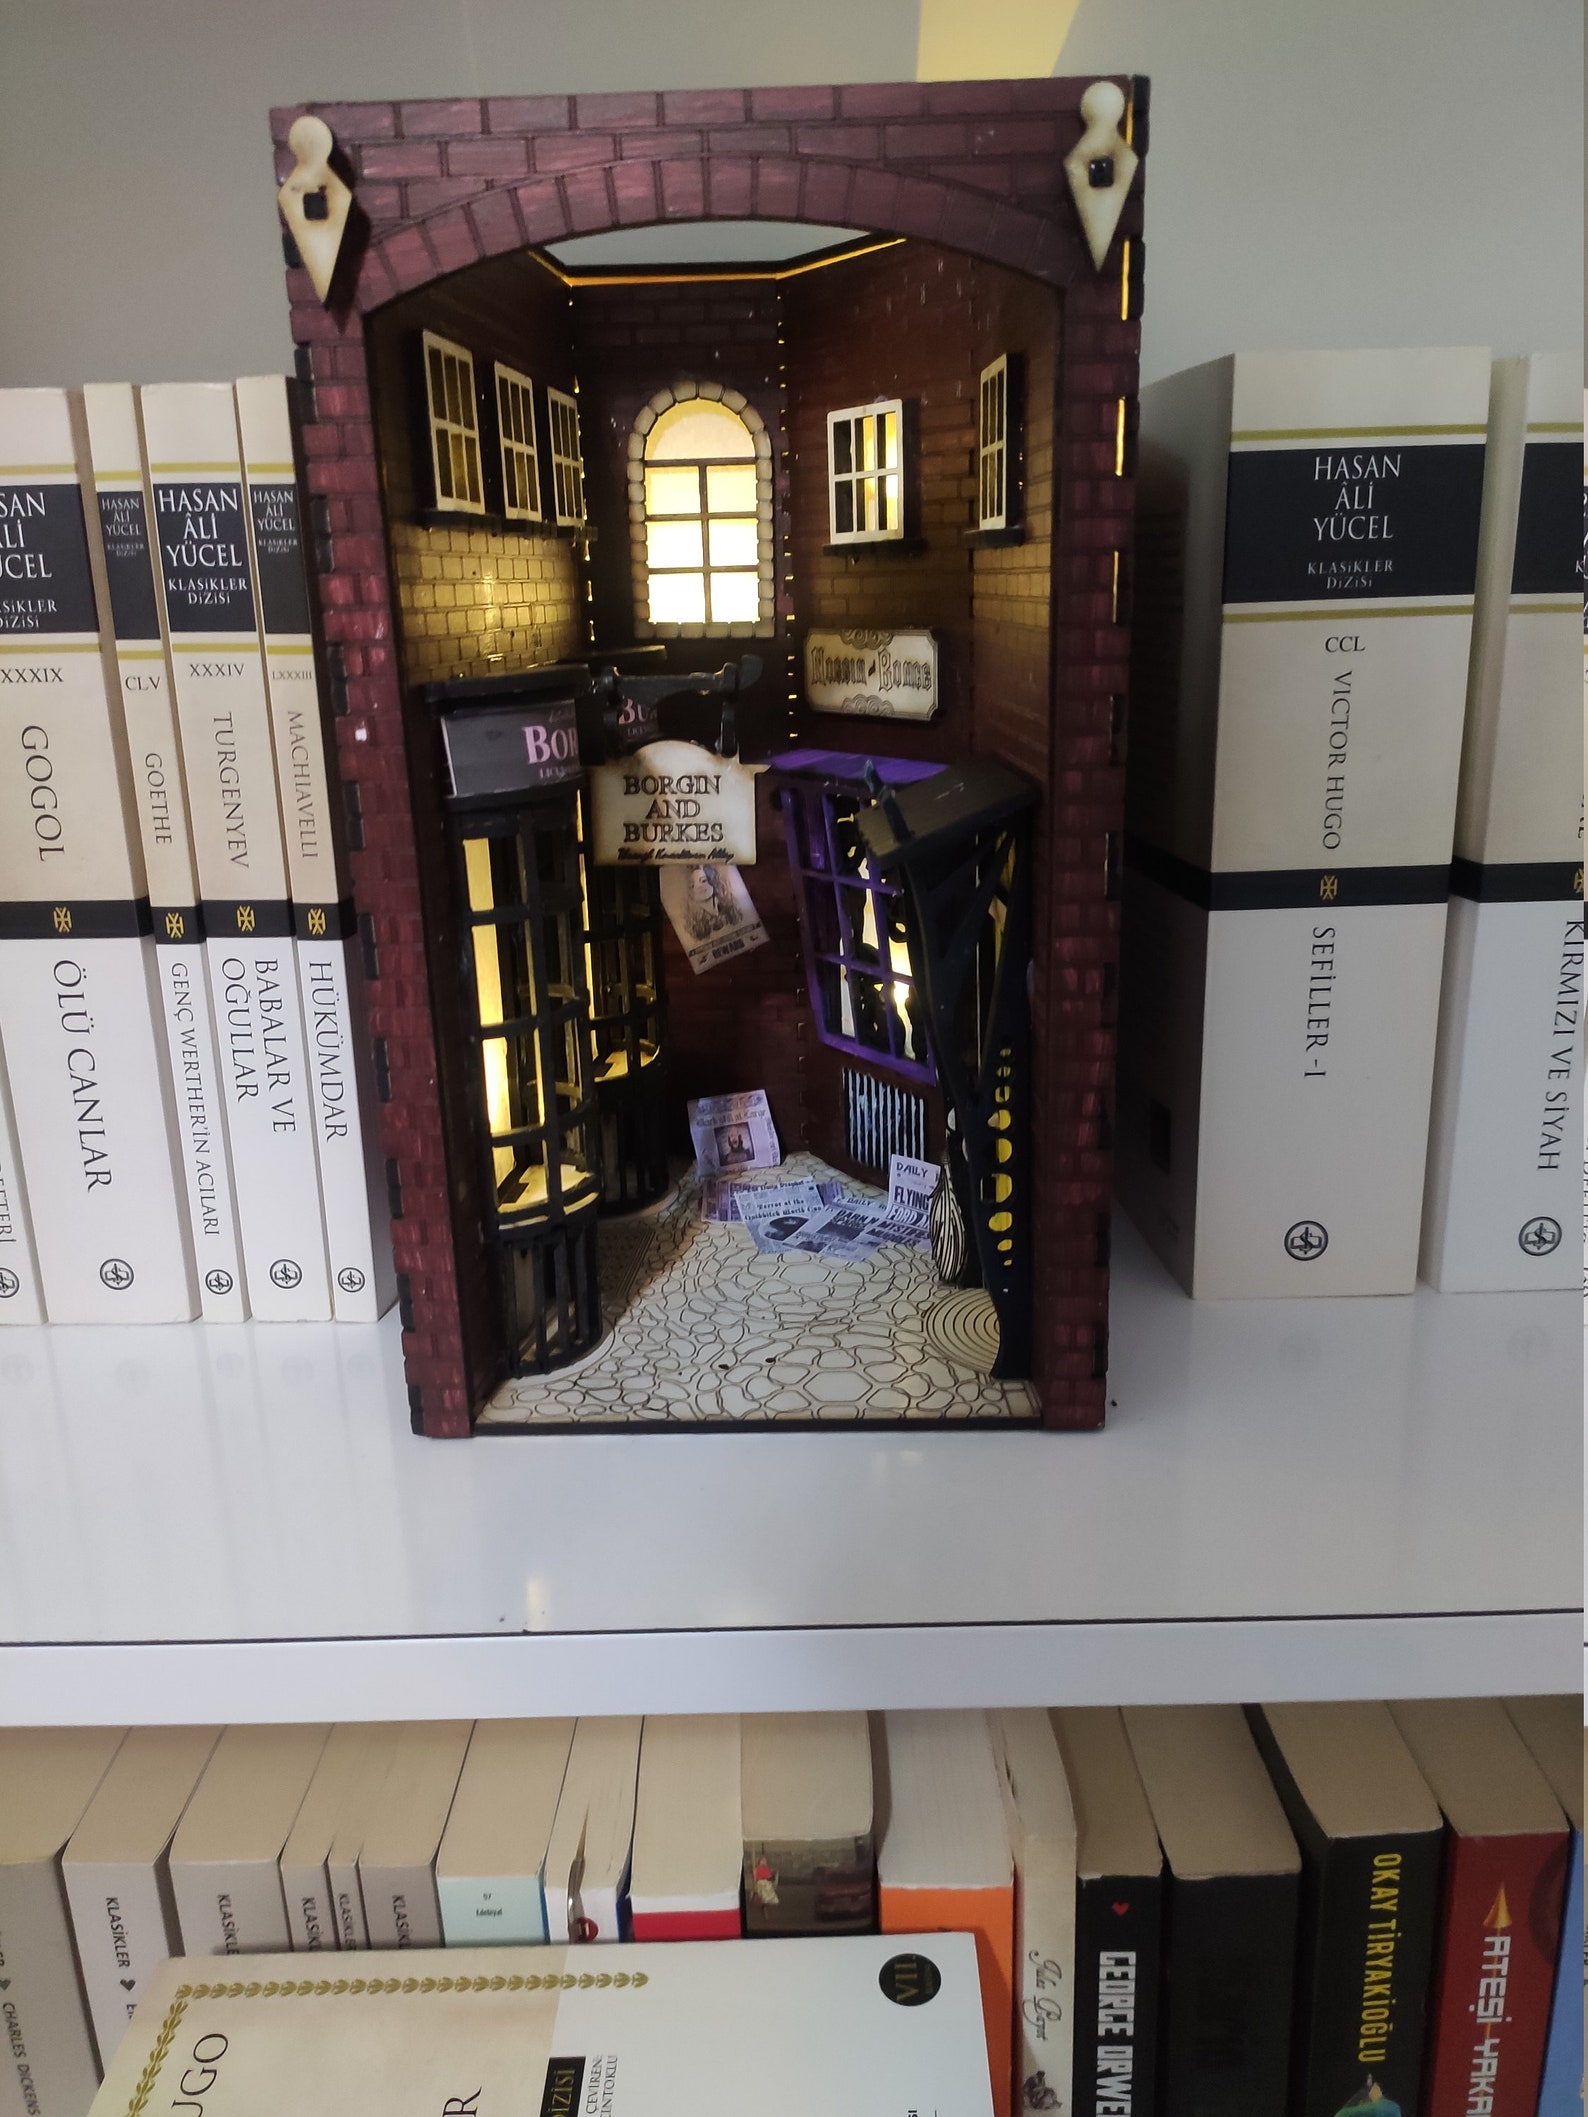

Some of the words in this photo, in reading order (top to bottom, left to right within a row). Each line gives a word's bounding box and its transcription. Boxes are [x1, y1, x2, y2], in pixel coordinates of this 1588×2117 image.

[1313, 453, 1401, 481] HASAN
[1334, 480, 1374, 511] ÂLİ
[0, 492, 47, 518] SAN
[102, 498, 140, 511] HASAN
[158, 487, 239, 513] HASAN
[183, 512, 219, 540] ÂLİ
[253, 490, 294, 504] HASAN
[1313, 512, 1394, 541] YÜCEL
[0, 553, 53, 579] CEL
[166, 541, 243, 568] YÜCEL
[1307, 558, 1394, 576] KLASİKLER
[168, 577, 249, 592] KLASİKLER
[189, 663, 245, 678] XXXIV
[1324, 635, 1366, 653] CCL
[125, 676, 161, 691] CLV
[272, 670, 313, 681] LXXXIII
[1327, 669, 1353, 769] VICTOR
[21, 725, 65, 862] GOGOL
[145, 752, 173, 845] GOETHE
[213, 711, 250, 869] TURGENYEV
[287, 710, 319, 859] MACHIAVELLI
[623, 774, 722, 795] BORGIN
[645, 798, 701, 819] AND
[1322, 775, 1345, 850] HUGO
[623, 822, 724, 843] BURKES
[53, 959, 95, 1036] ÖLÜ
[1305, 925, 1337, 1053] SEFİLLER
[1552, 919, 1584, 1037] KIRMIZI
[221, 957, 260, 1103] OĞULLAR
[254, 958, 294, 1092] BABALAR
[309, 960, 349, 1143] HÜKÜMDAR
[1547, 1045, 1574, 1080] VE
[67, 1048, 113, 1193] CANLAR
[171, 962, 195, 1023] GENÇ
[195, 1160, 221, 1236] ACILARI
[271, 1097, 296, 1133] VE
[1537, 1090, 1571, 1172] SİYAH
[894, 1185, 930, 1211] FLYING
[896, 1161, 928, 1178] DAILY
[1370, 1853, 1402, 1912] OKAY
[106, 1896, 131, 1969] KLASİKLER
[1098, 1951, 1137, 2037] GEORGE
[1358, 1918, 1402, 2062] TİRYAKİOĞLU
[1469, 1935, 1513, 2023] ATEŞİ
[3, 2002, 26, 2059] CHARLES
[17, 2063, 41, 2117] DICKENS
[172, 2033, 229, 2117] UGO
[1096, 2045, 1134, 2117] ORWE
[1466, 2038, 1501, 2117] YAKA
